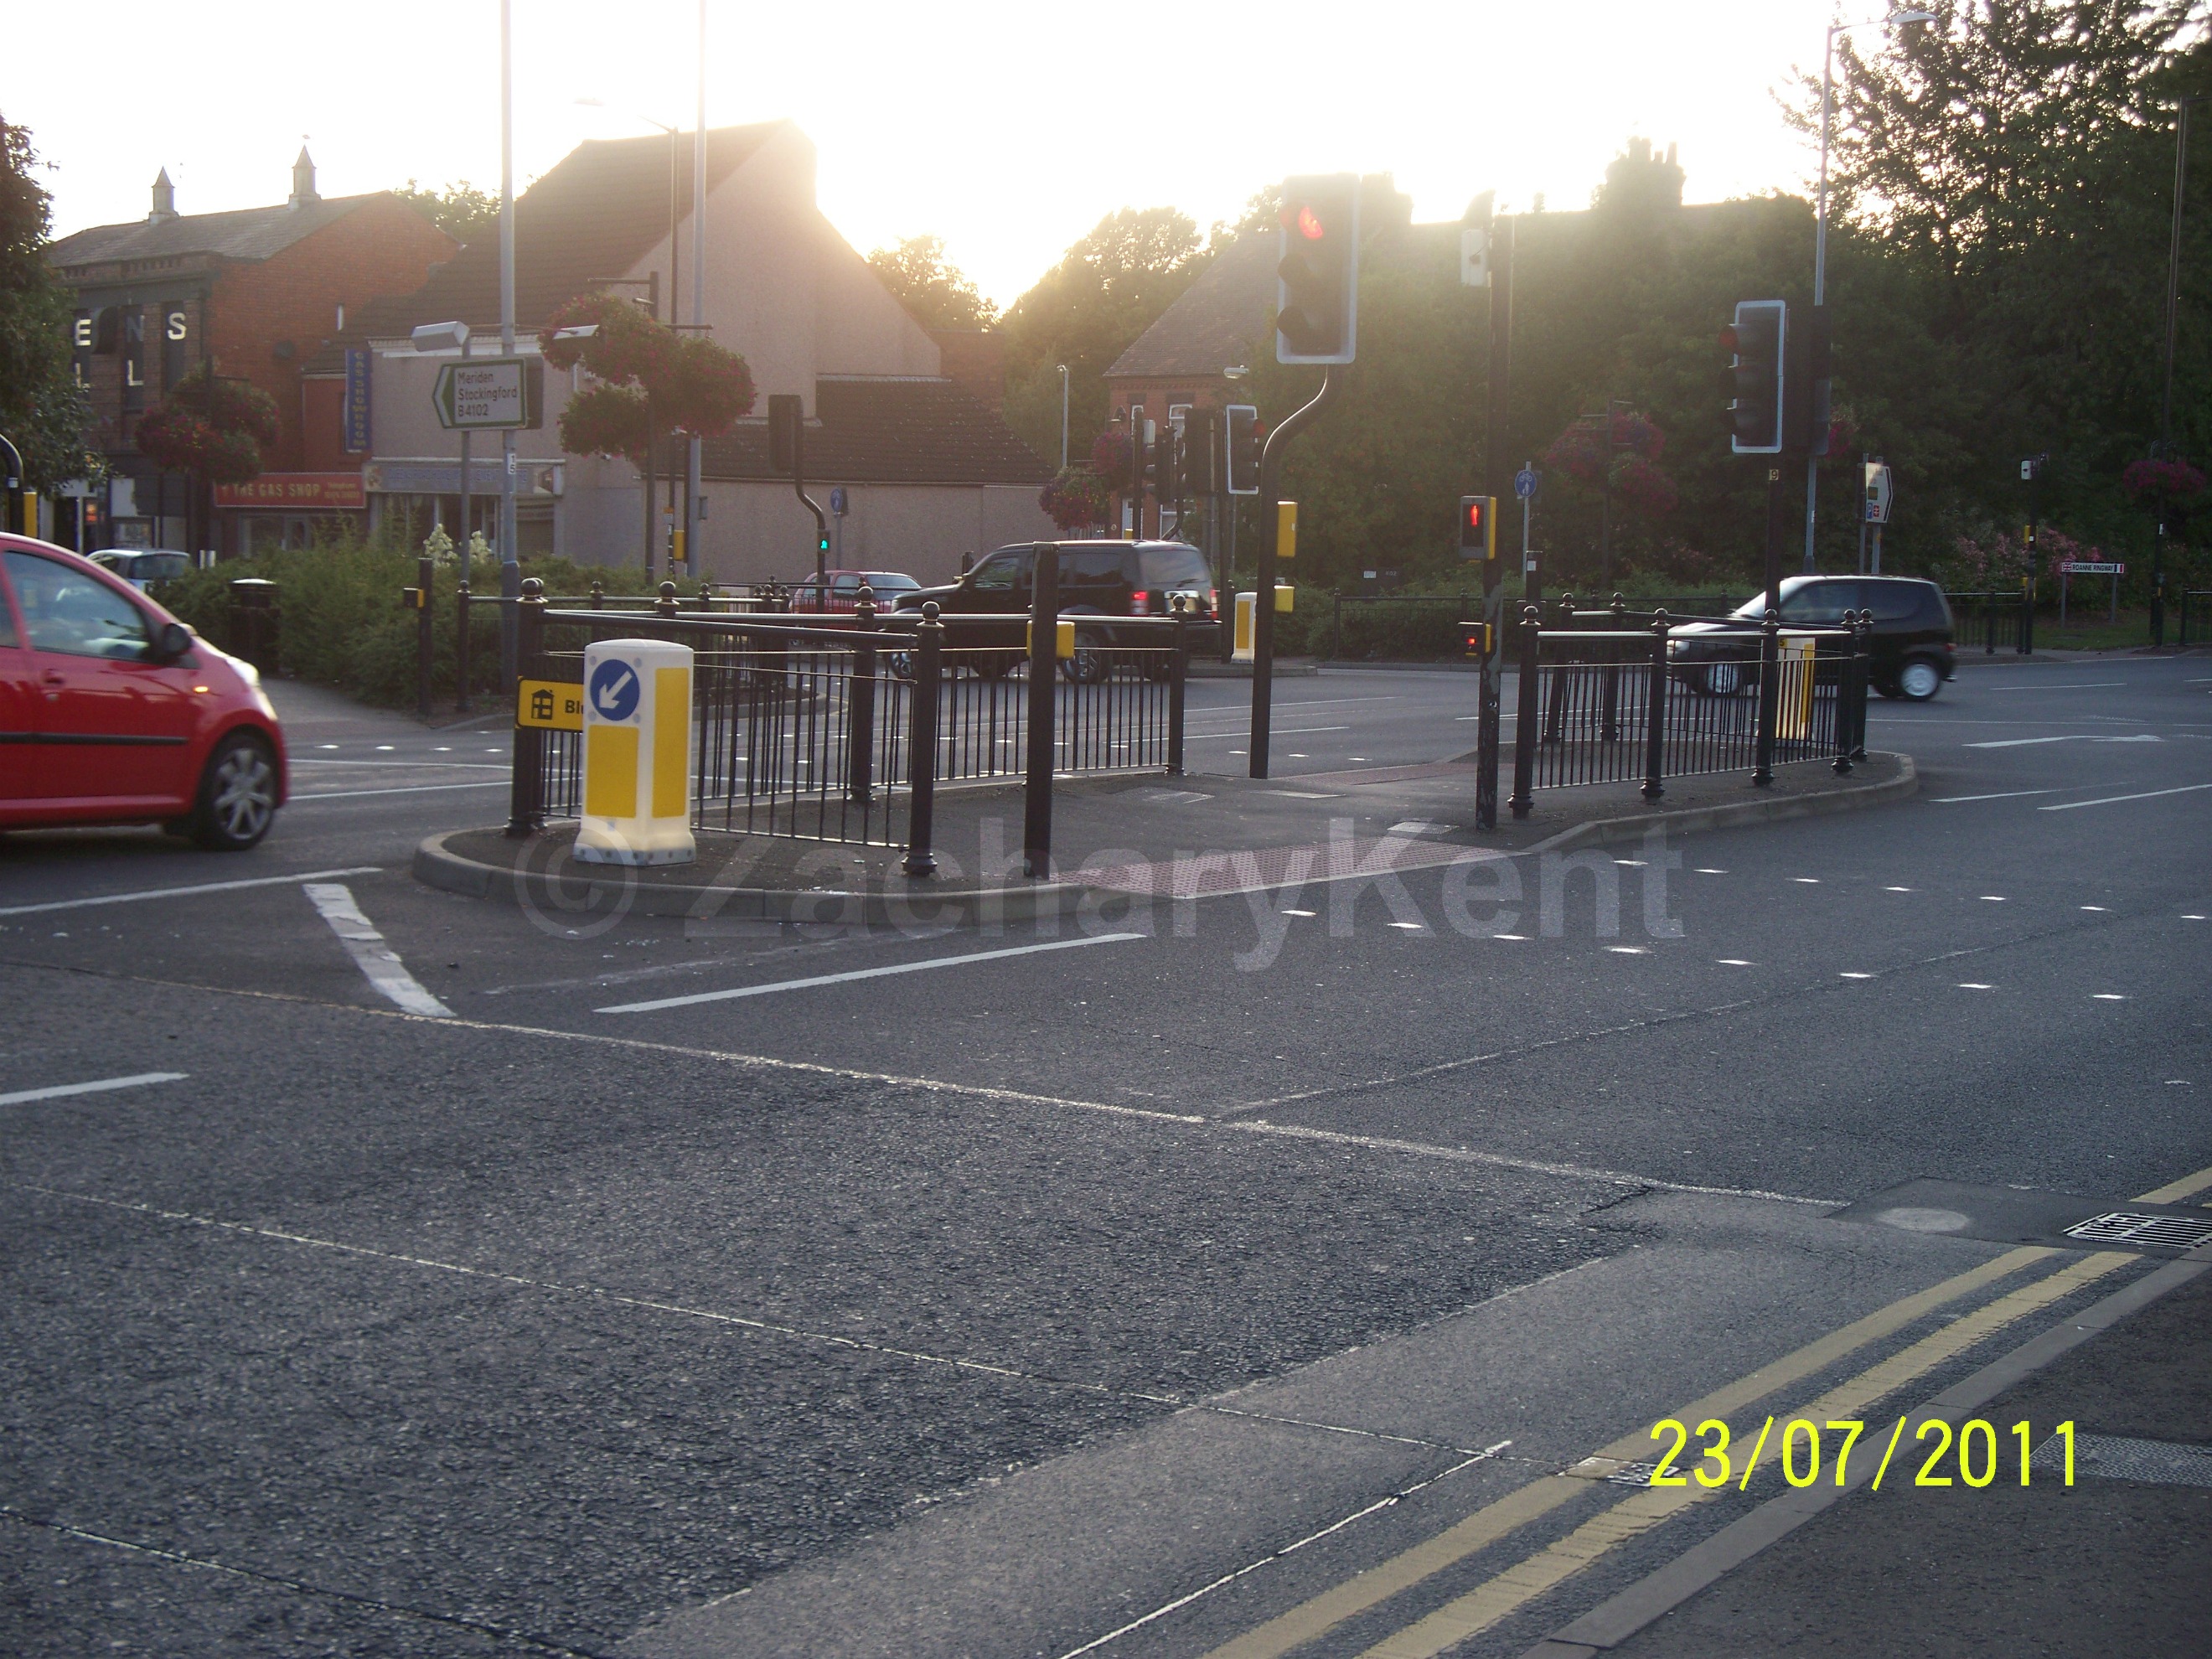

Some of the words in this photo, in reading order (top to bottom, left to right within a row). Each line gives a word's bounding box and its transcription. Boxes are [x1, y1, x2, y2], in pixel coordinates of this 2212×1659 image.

[457, 371, 494, 384] Meriden
[457, 386, 517, 401] Stockingford
[259, 483, 283, 497] GAS
[288, 483, 321, 497] SHOP
